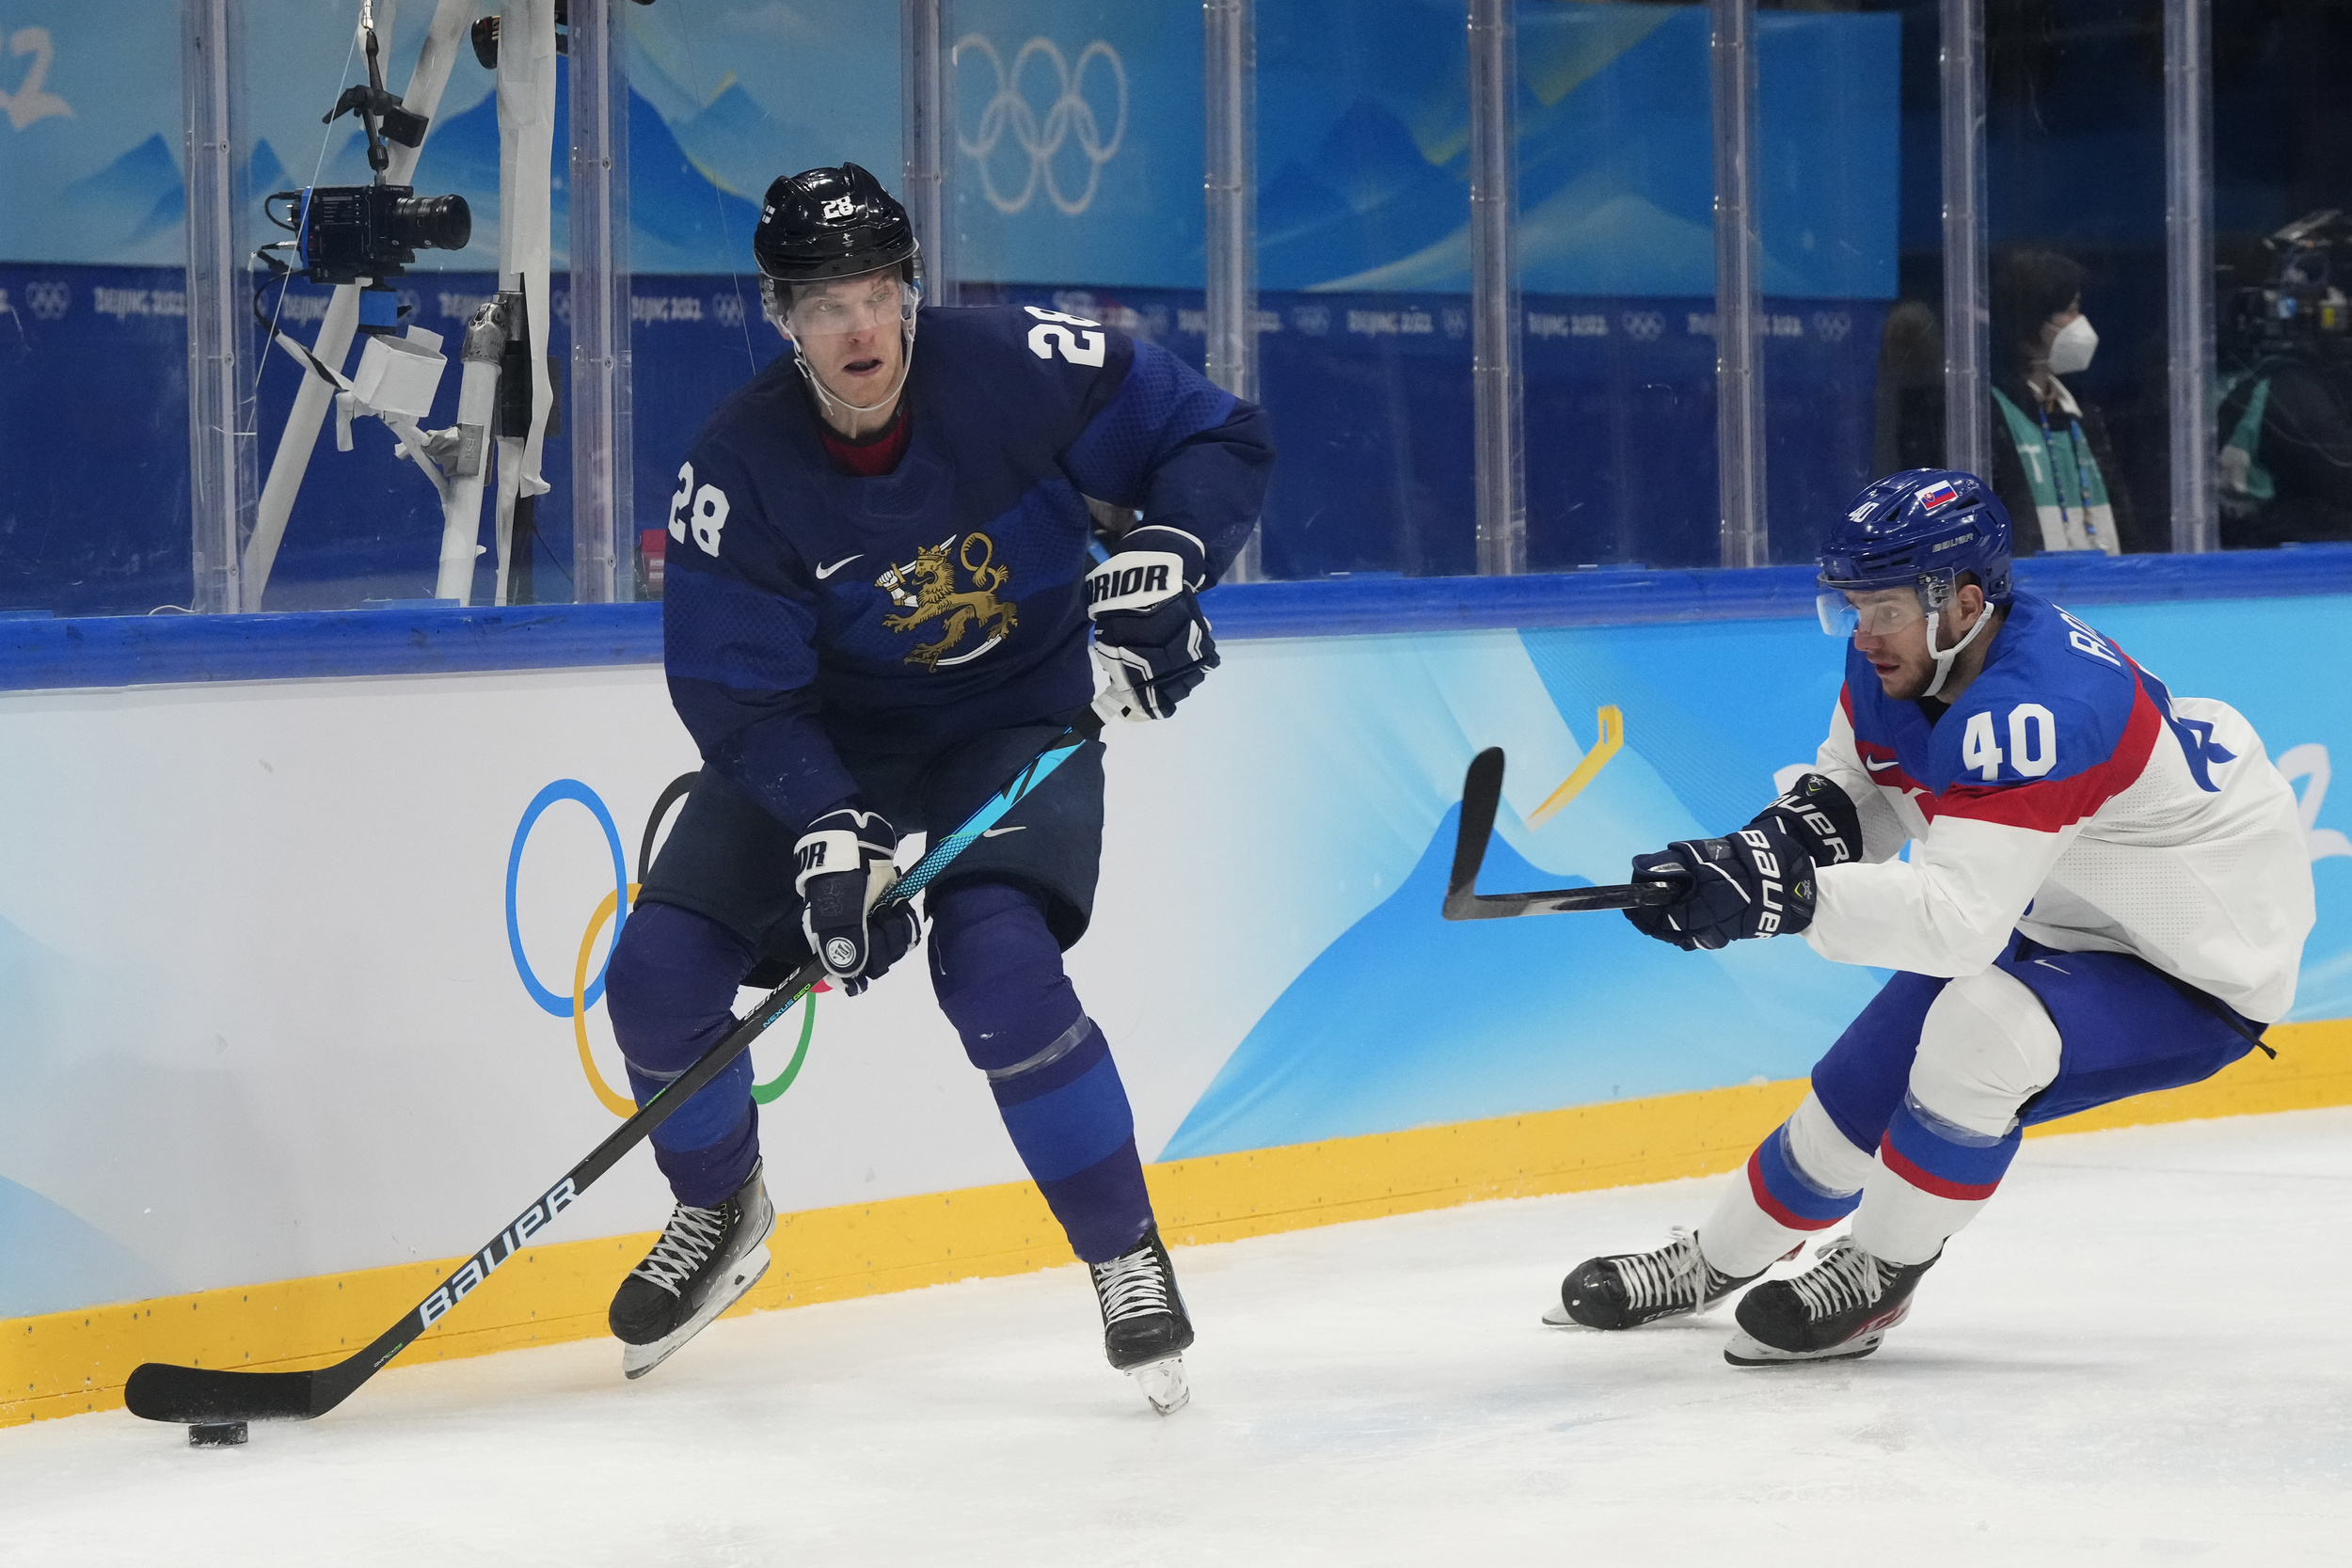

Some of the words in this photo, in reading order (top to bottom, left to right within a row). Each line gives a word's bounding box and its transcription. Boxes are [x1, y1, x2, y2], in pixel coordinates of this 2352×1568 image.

[0, 26, 73, 130] 2
[820, 195, 854, 220] 28
[1024, 306, 1105, 368] 28
[668, 461, 730, 558] 28
[1848, 500, 1880, 523] 40
[2052, 604, 2122, 667] RO
[1963, 703, 2058, 782] 40
[762, 998, 795, 1028] NEXUS
[793, 983, 812, 1002] GEO
